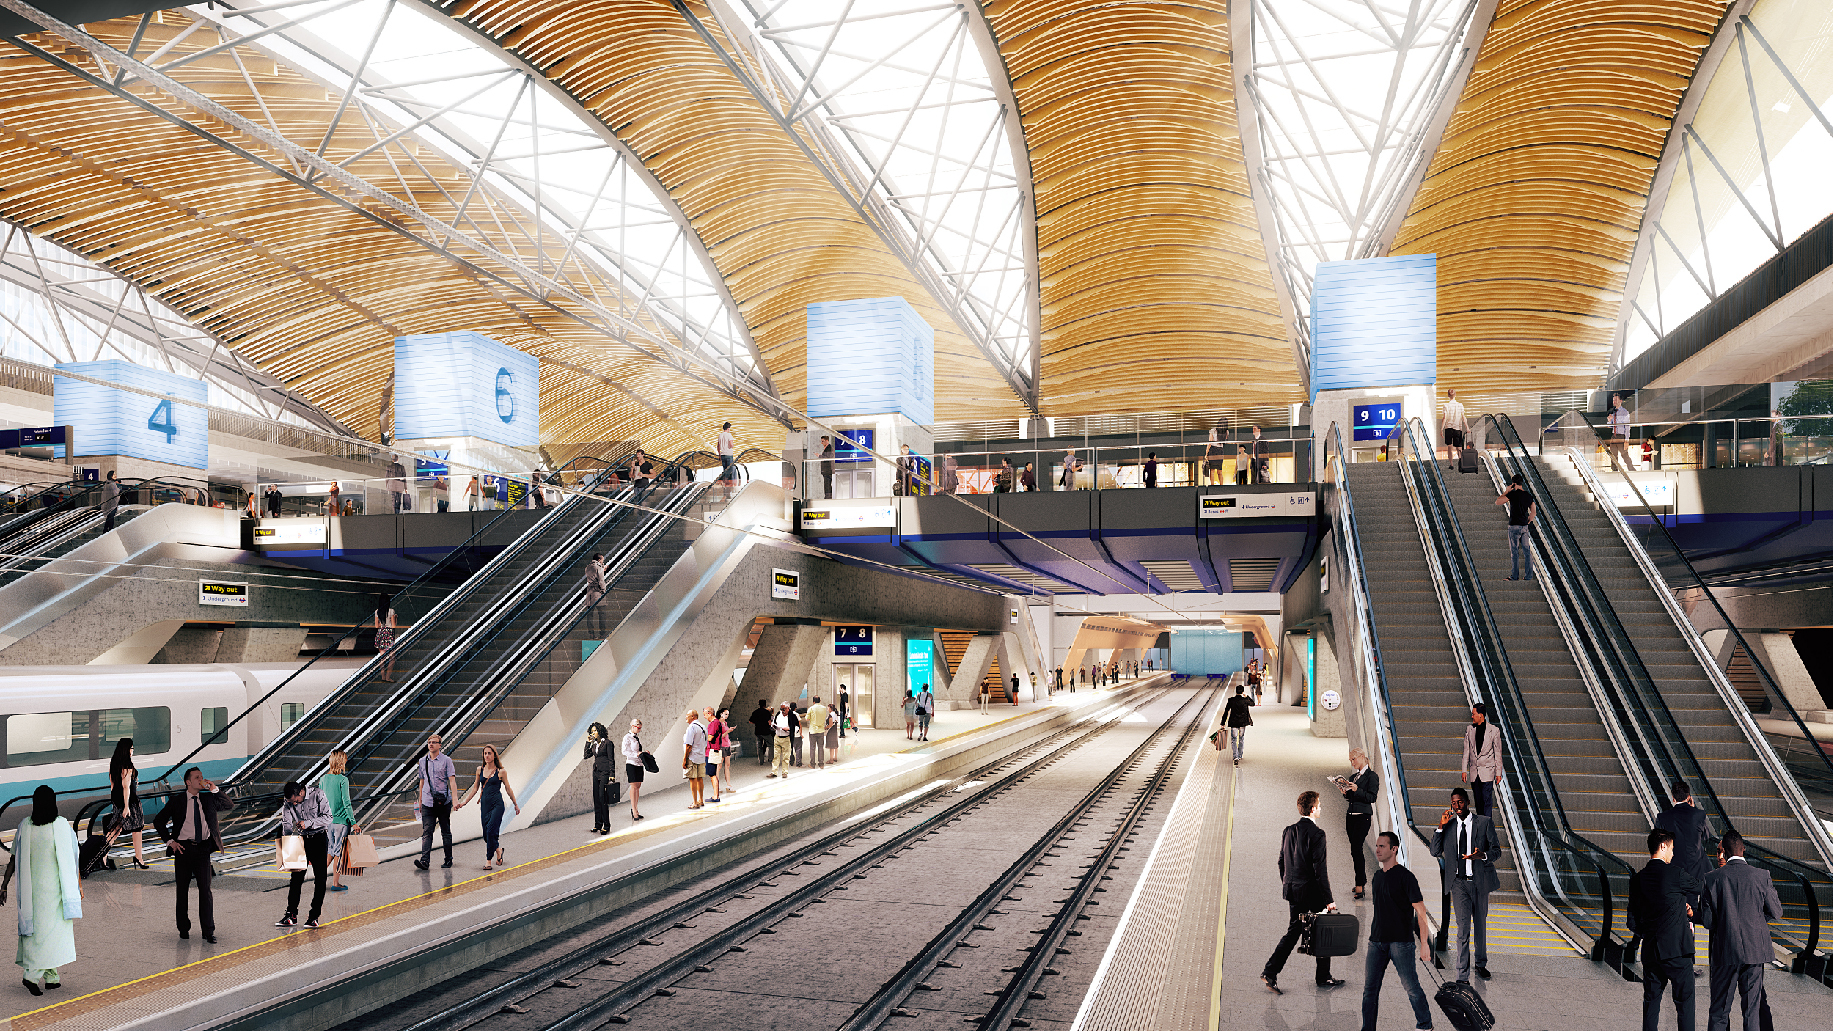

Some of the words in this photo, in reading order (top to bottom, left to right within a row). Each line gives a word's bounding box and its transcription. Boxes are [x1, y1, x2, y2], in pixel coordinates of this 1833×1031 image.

[495, 367, 517, 424] 6
[148, 392, 177, 444] 4
[1361, 411, 1369, 421] 9
[1379, 409, 1395, 420] 10
[859, 435, 866, 445] 8
[88, 472, 94, 480] 4
[211, 585, 225, 594] Way
[840, 628, 847, 638] 7
[858, 628, 866, 638] 8
